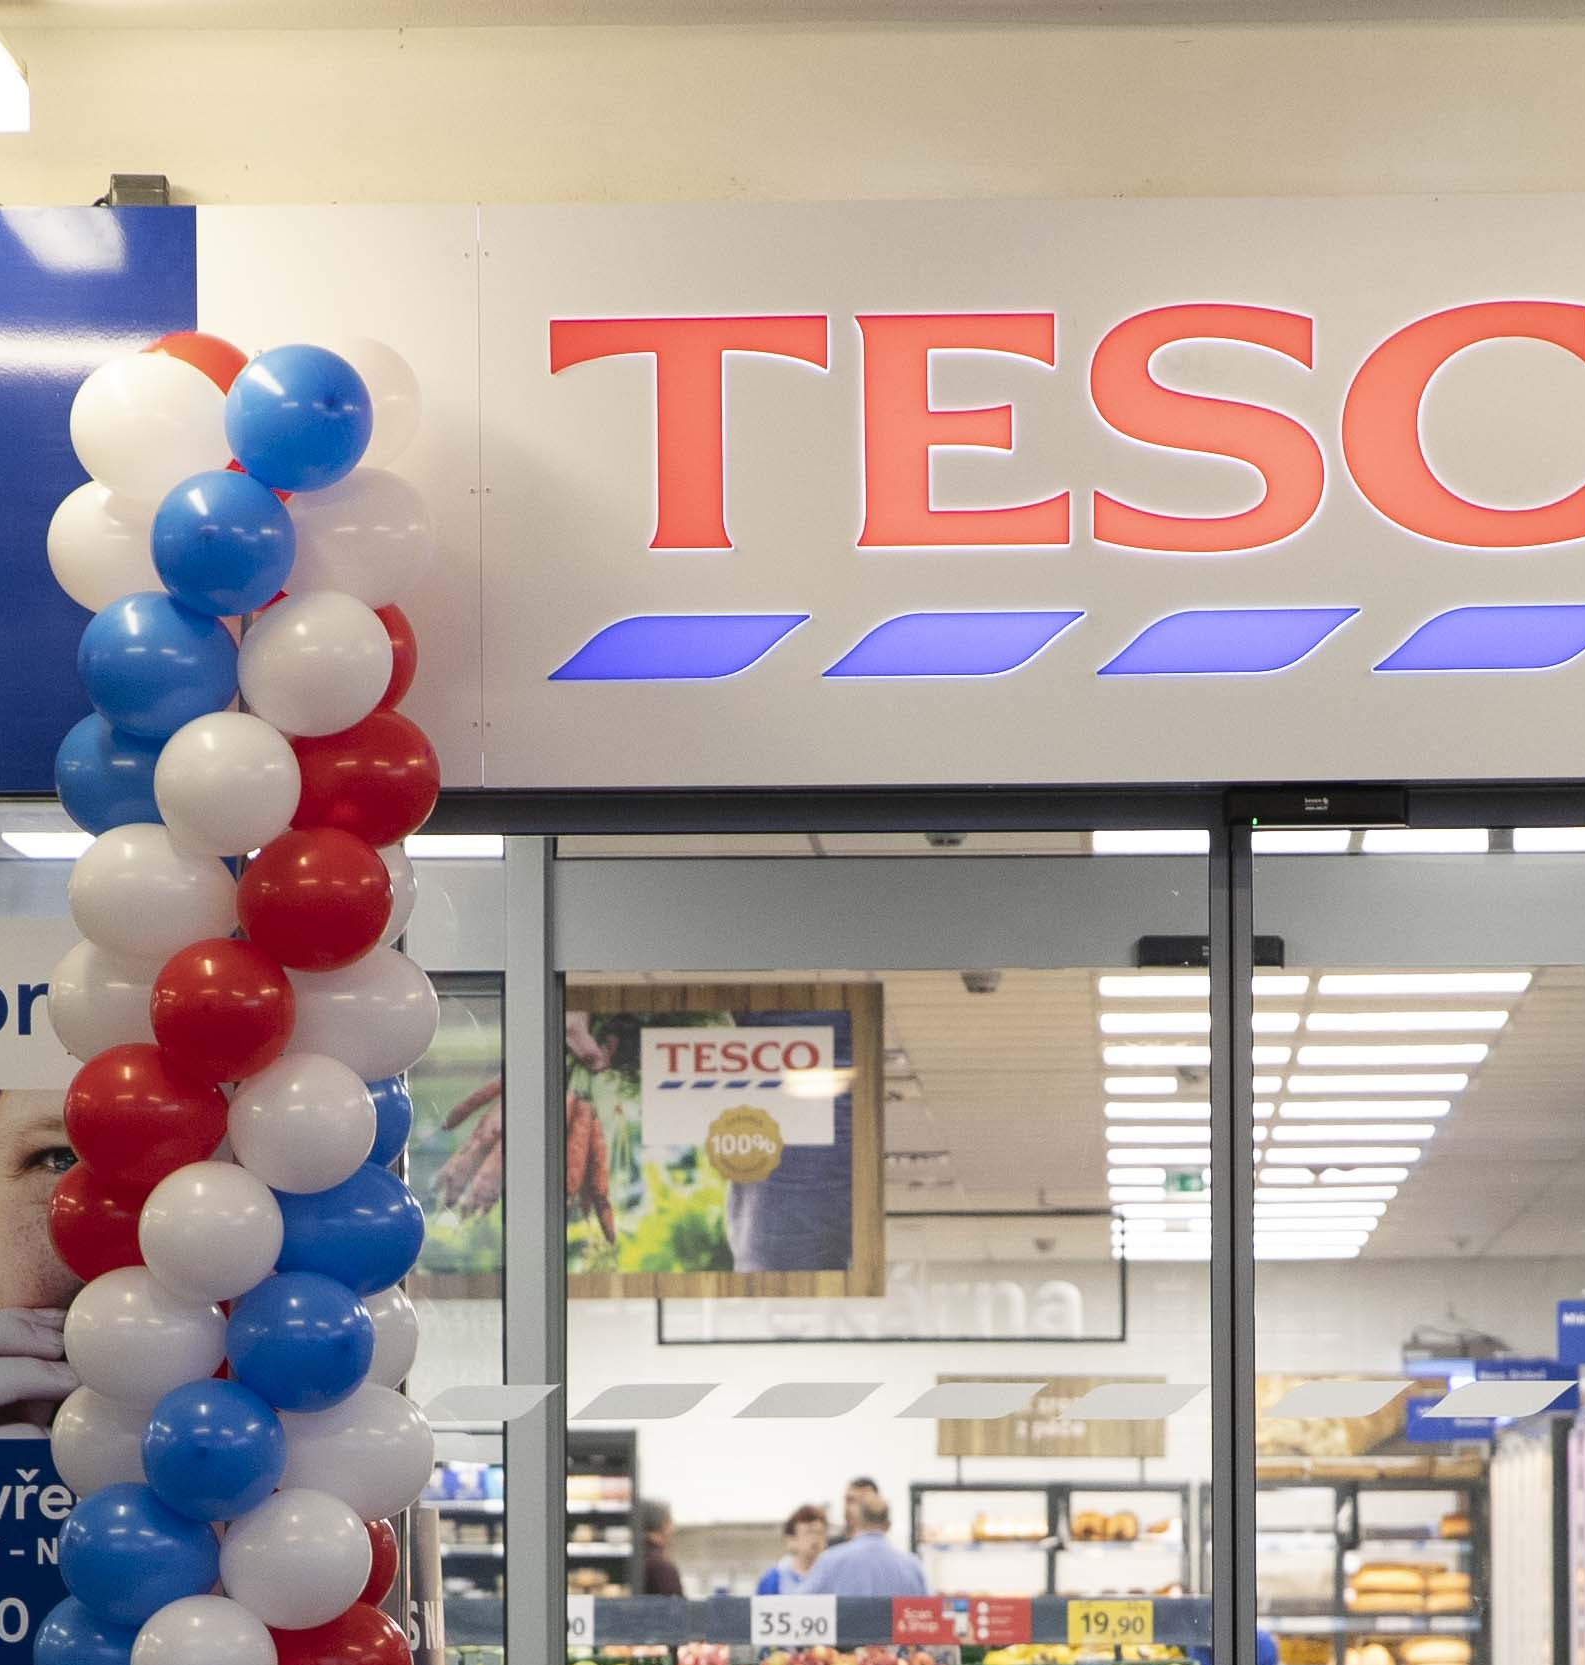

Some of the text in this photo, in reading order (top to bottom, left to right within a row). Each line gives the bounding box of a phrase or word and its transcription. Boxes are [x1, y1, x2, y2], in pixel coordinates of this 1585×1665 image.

[656, 1040, 820, 1074] TESCO
[712, 1133, 778, 1155] 100%
[37, 1537, 59, 1565] N
[759, 1612, 829, 1637] 35,90
[1081, 1612, 1145, 1637] 19,90
